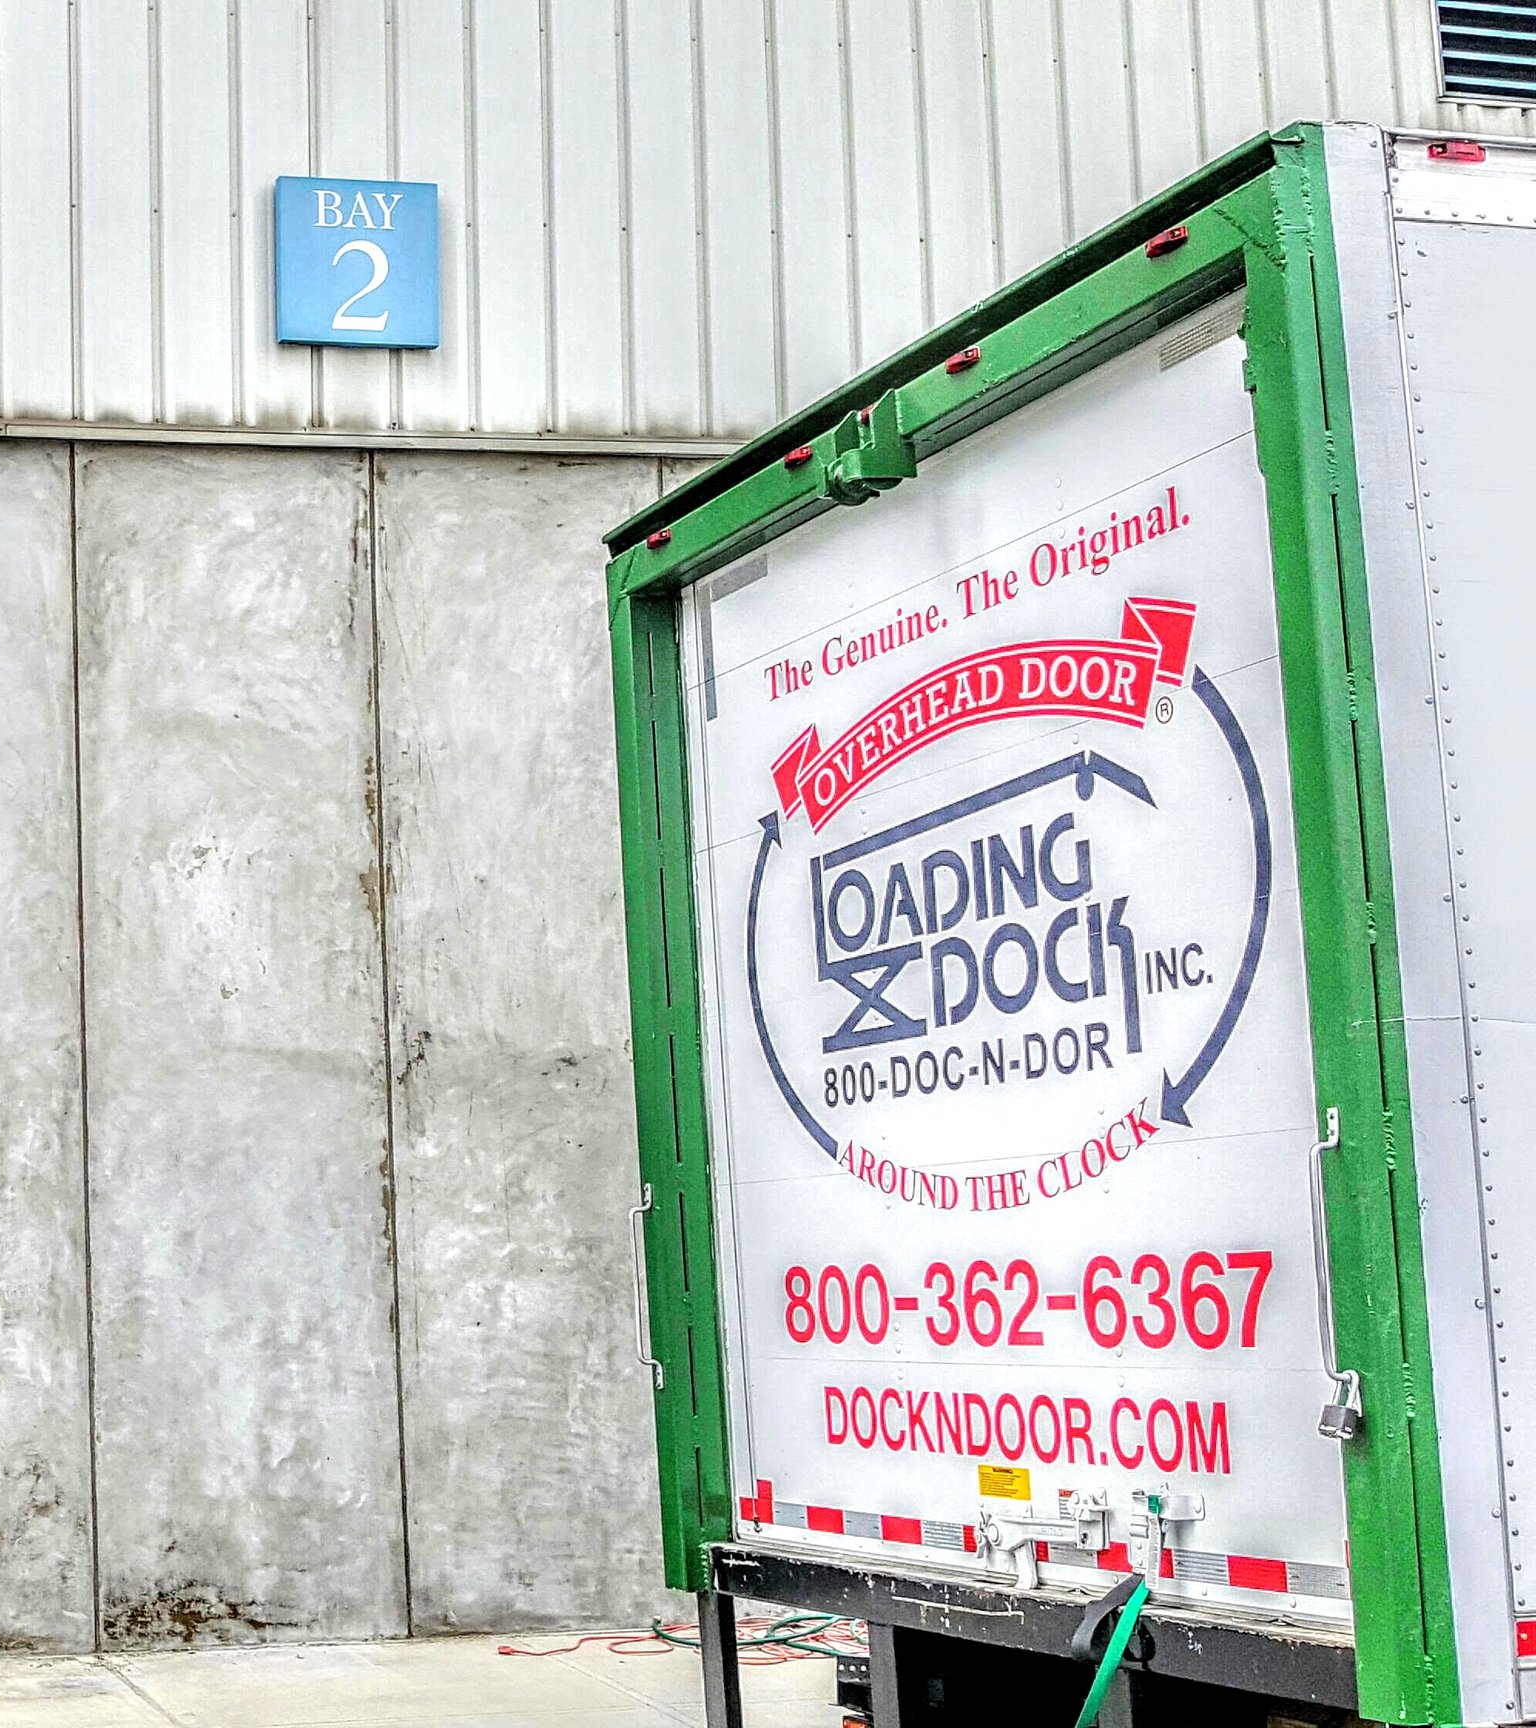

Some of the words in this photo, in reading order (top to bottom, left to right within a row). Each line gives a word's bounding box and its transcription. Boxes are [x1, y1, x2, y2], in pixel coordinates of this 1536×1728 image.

[312, 189, 404, 230] BAY
[331, 239, 390, 332] 2
[764, 654, 814, 702] The
[821, 606, 948, 676] Genuine.
[956, 569, 1019, 620] The
[1029, 486, 1191, 588] Original.
[814, 664, 1003, 807] OVERHEAD
[1017, 654, 1139, 708] DOOR
[809, 812, 1093, 981] LOADING
[931, 895, 1143, 1054] DOCK
[1144, 942, 1214, 995] INC.
[823, 1021, 1114, 1108] 800-DOC-N-DOR
[837, 1140, 959, 1210] AROUND
[965, 1170, 1031, 1212] THE
[1036, 1097, 1160, 1198] CLOCK
[784, 1251, 1273, 1350] 800-362-6367
[823, 1385, 1231, 1475] DOCKNDOOR.COM
